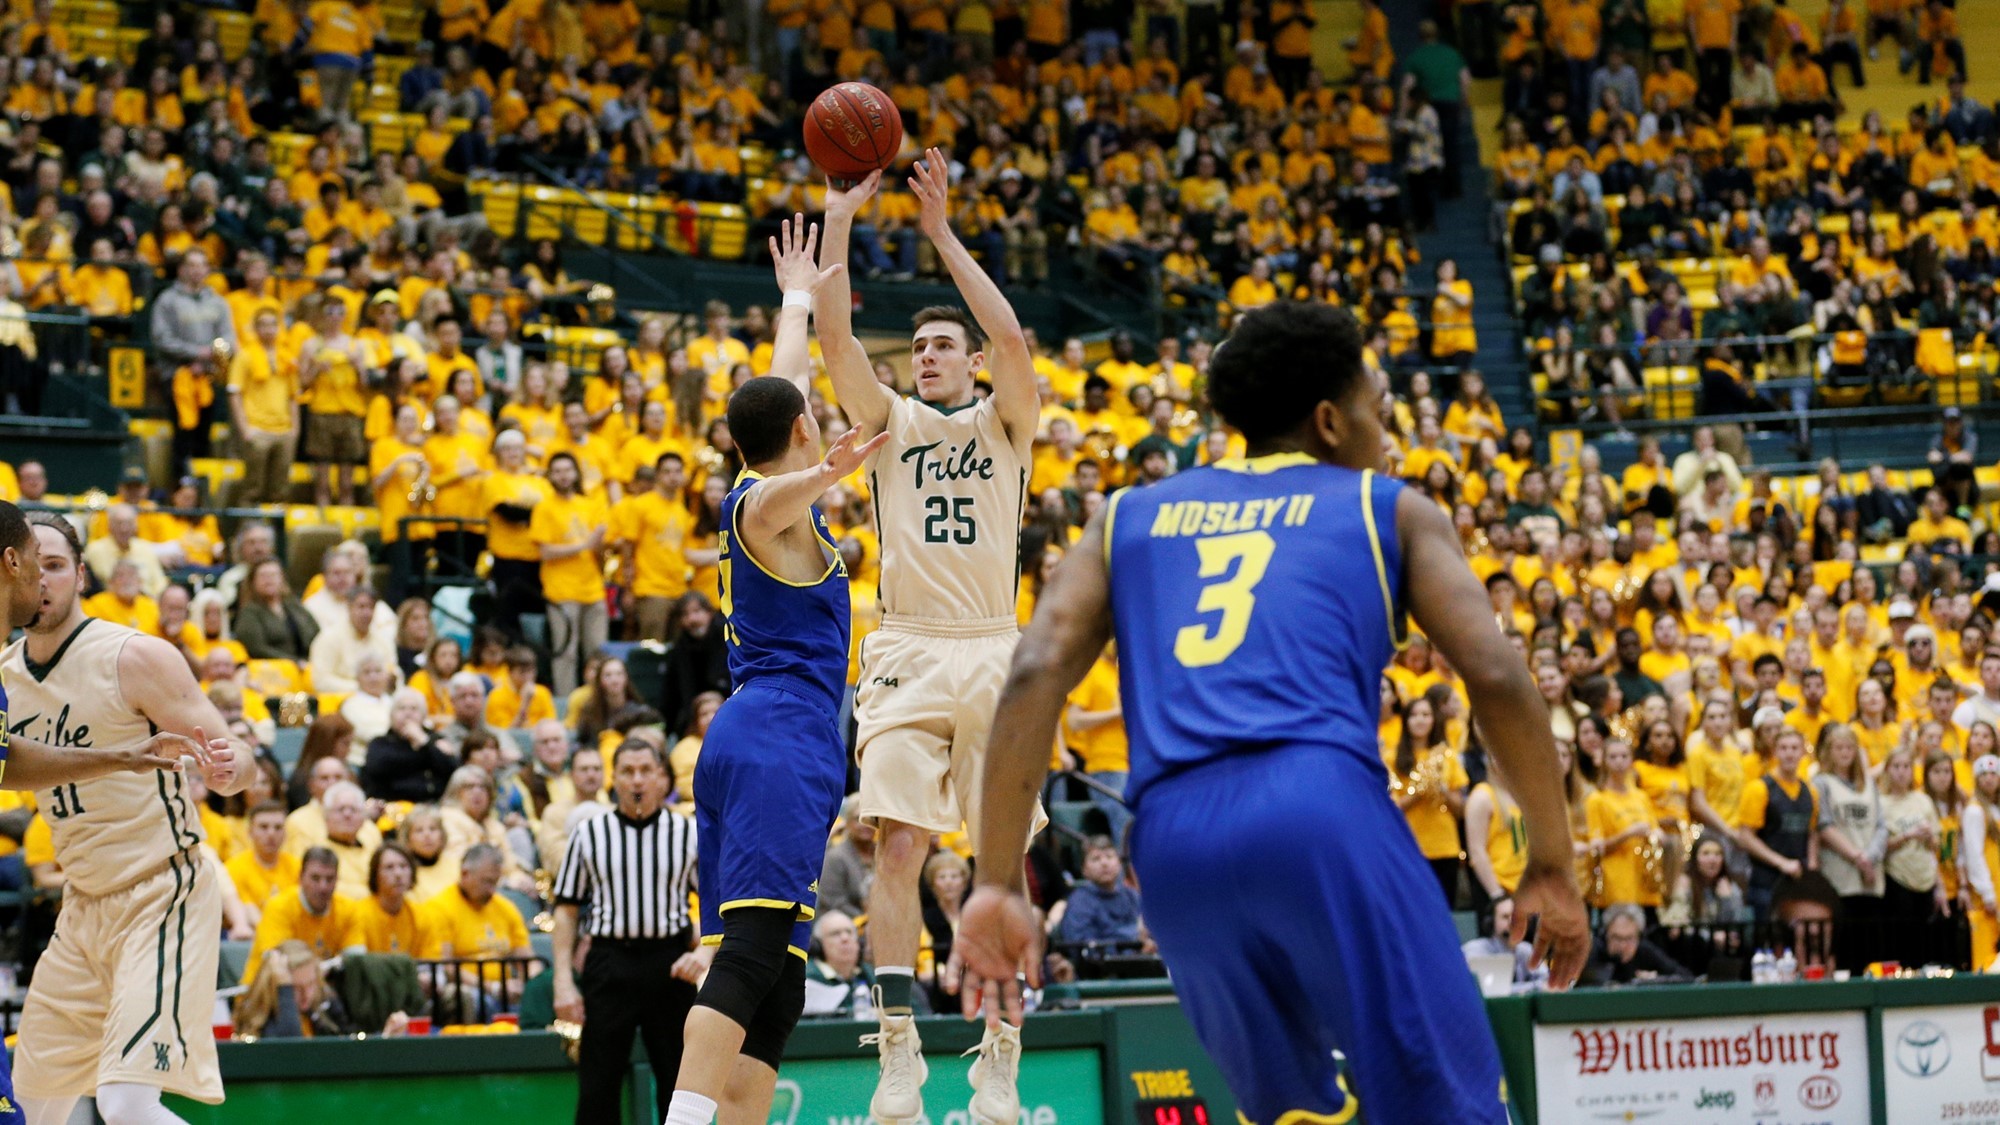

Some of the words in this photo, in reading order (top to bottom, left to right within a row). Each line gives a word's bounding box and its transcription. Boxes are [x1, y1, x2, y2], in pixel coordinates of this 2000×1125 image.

[901, 437, 994, 489] Tribe
[924, 495, 977, 545] 25
[1150, 497, 1287, 538] MOSLEY
[1283, 494, 1316, 528] II
[1173, 529, 1277, 668] 3
[9, 703, 93, 748] Tibe
[1571, 1023, 1840, 1076] Williamsburg
[1130, 1068, 1195, 1099] TRIBE
[1694, 1086, 1736, 1110] Jeep
